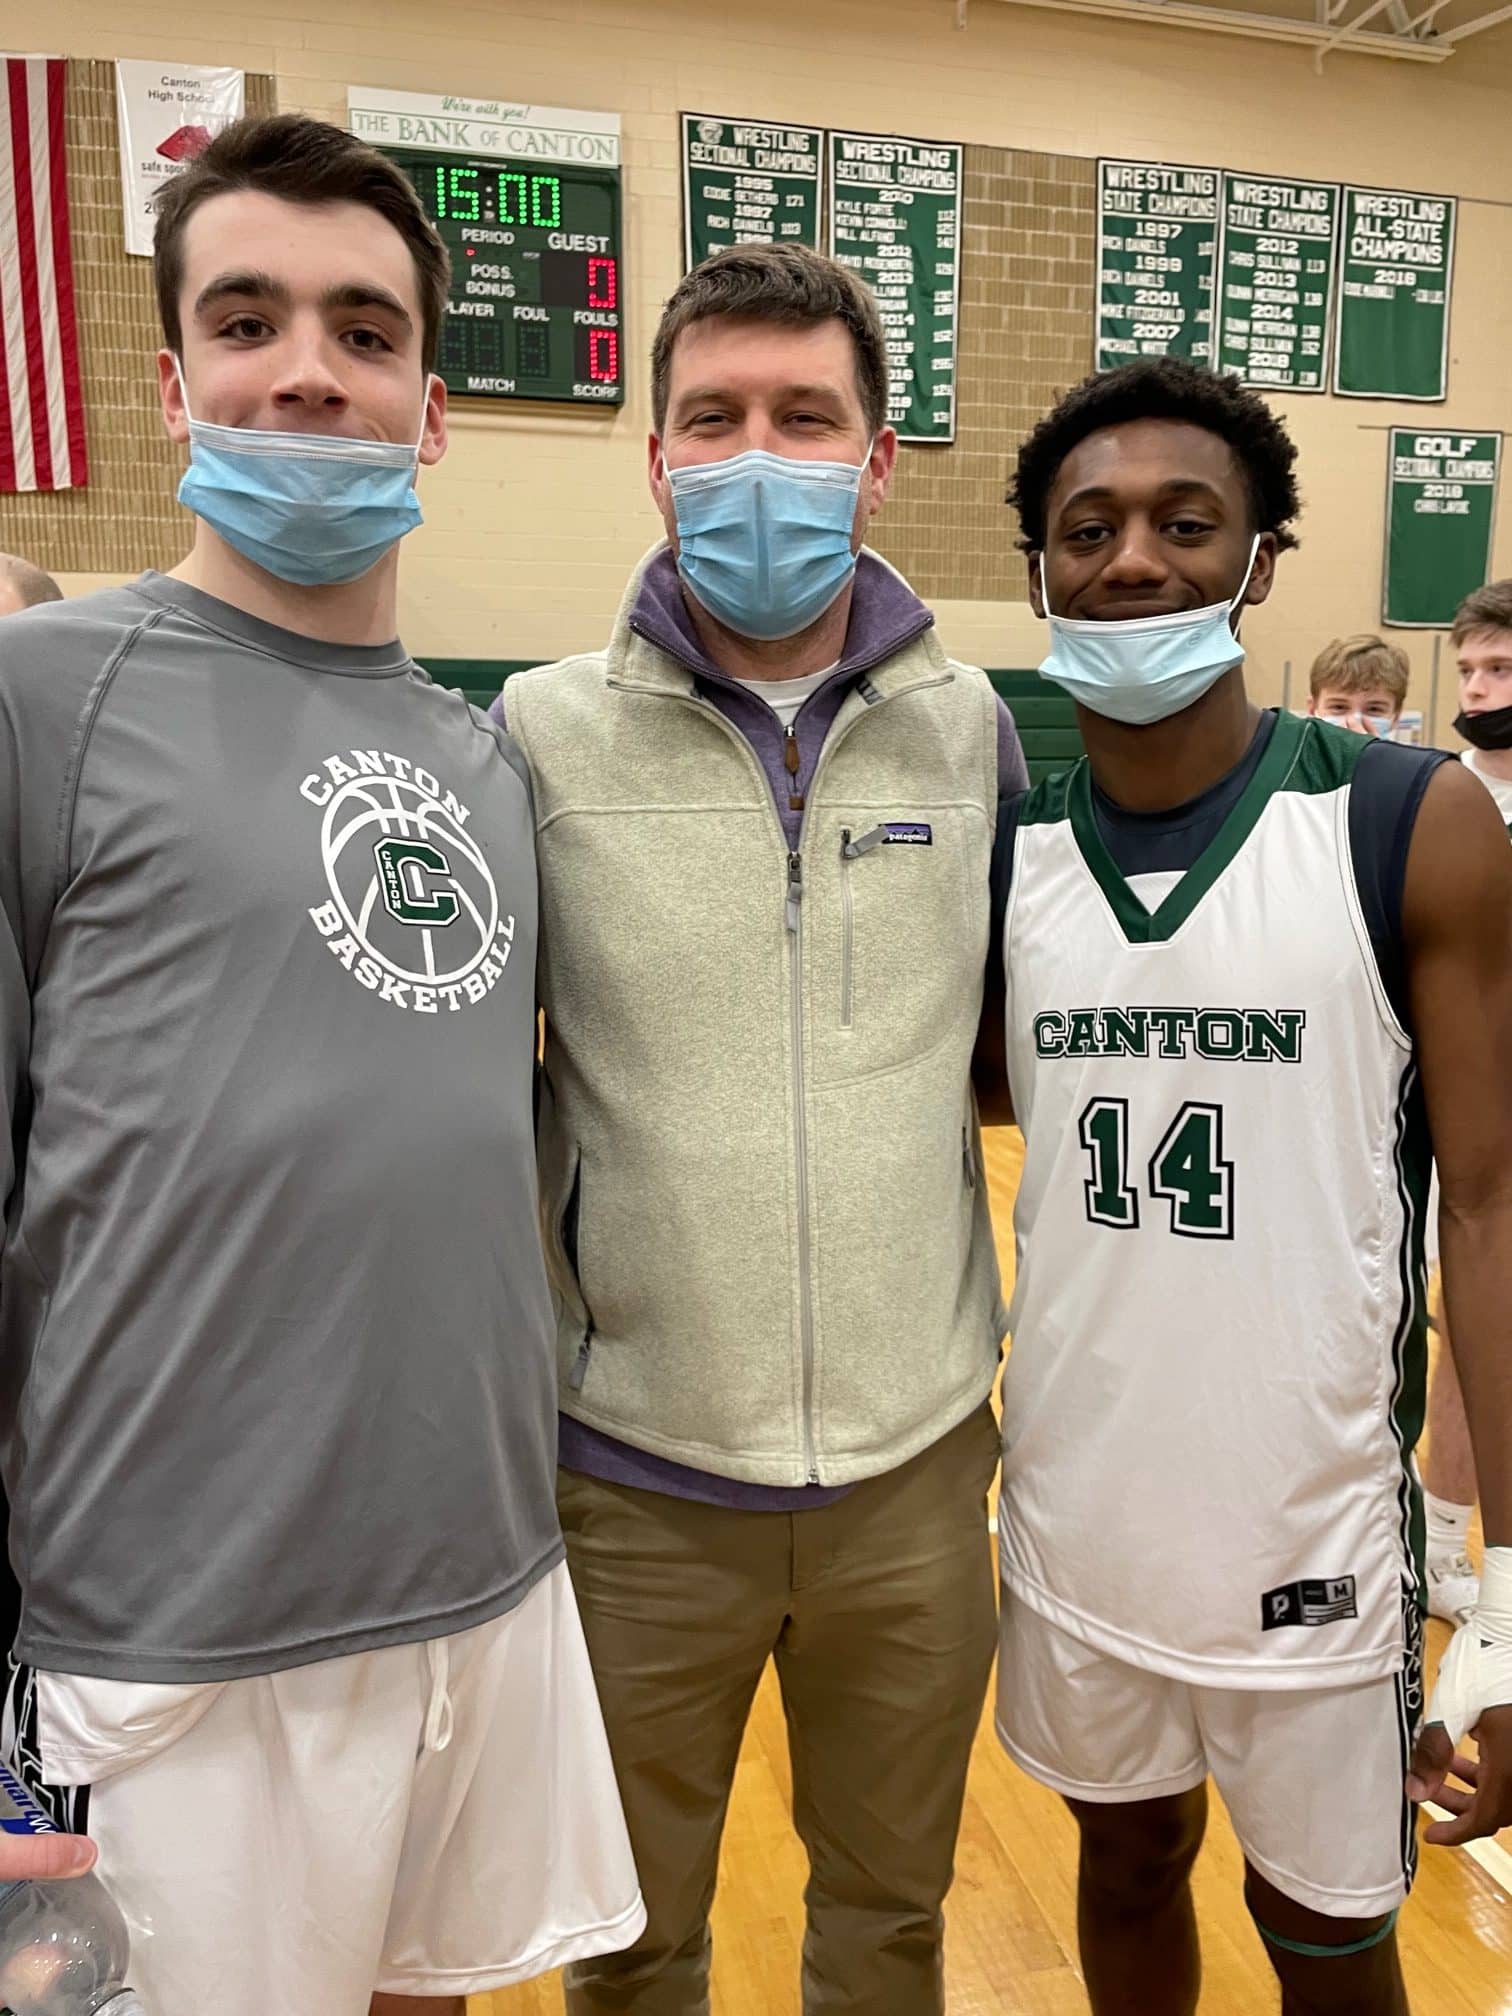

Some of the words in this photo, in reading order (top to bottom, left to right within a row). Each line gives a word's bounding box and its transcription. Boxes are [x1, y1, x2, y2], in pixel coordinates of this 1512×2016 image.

[161, 76, 200, 88] Canton
[149, 90, 174, 102] High
[177, 92, 215, 104] School
[475, 103, 499, 115] with
[500, 106, 531, 121] you!
[355, 113, 389, 133] THE
[397, 117, 471, 148] BANK
[480, 130, 501, 146] OF
[508, 130, 615, 161] CANTON
[733, 127, 810, 152] WRESTLING
[141, 160, 161, 172] safe
[690, 142, 751, 167] SECTIONAL
[755, 150, 816, 173] CHAMPIONS
[842, 140, 951, 169] WRESTLING
[836, 160, 895, 183] SECTIONAL
[897, 165, 956, 188] CHAMPIONS
[1106, 166, 1214, 195] WRESTLING
[436, 167, 560, 228] 15:00
[1103, 189, 1143, 213] STATE
[1148, 193, 1216, 217] CHAMPIONS
[1233, 181, 1329, 211] WRESTLING
[1354, 194, 1446, 222] WRESTLING
[1135, 222, 1183, 239] 1997
[1228, 204, 1265, 228] STATE
[1268, 209, 1331, 235] CHAMPIONS
[1353, 215, 1443, 243] ALL-STATE
[461, 228, 515, 245] PERIOD
[548, 232, 610, 252] GUEST
[1256, 237, 1299, 255] 2012
[1351, 237, 1443, 264] CHAMPIONS
[471, 264, 514, 280] POSS.
[1252, 271, 1297, 288] 2013
[466, 281, 516, 298] BONUS
[1134, 289, 1180, 306] 2001
[513, 306, 550, 321] FOUL
[573, 311, 618, 327] FOULS
[1250, 304, 1294, 320] 2014
[1132, 322, 1181, 340] 2007
[589, 329, 617, 381] 0
[885, 341, 914, 354] 015
[468, 377, 515, 392] MATCH
[1414, 436, 1477, 458] GOLF
[299, 749, 471, 826] CANTON
[372, 836, 461, 927] C
[381, 850, 402, 910] CANTON
[307, 899, 515, 1014] BASKETBALL
[1033, 1006, 1306, 1064] CANTON
[1078, 1096, 1235, 1240] 14
